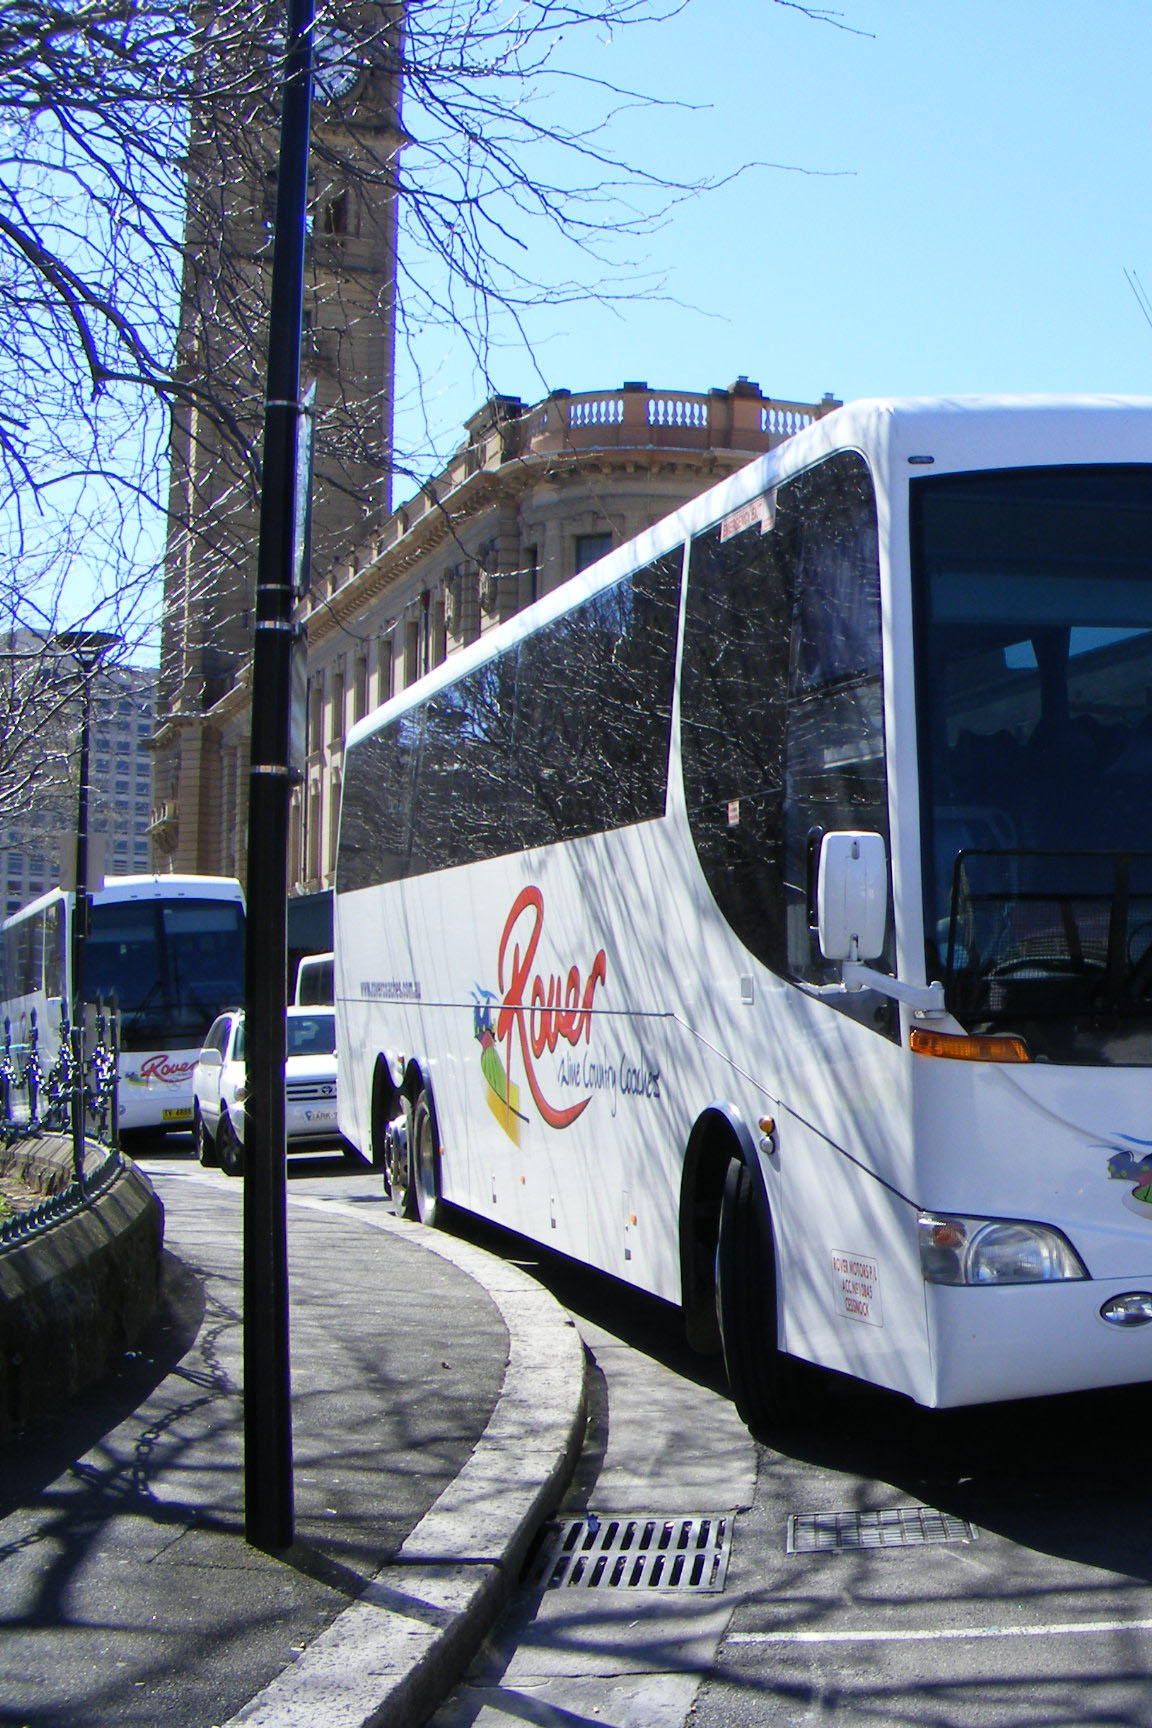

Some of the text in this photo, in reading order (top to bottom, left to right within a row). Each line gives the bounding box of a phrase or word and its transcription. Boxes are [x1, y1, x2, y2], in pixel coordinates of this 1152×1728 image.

[498, 885, 606, 1129] Rover
[558, 1044, 660, 1117] Wine Country Coaches
